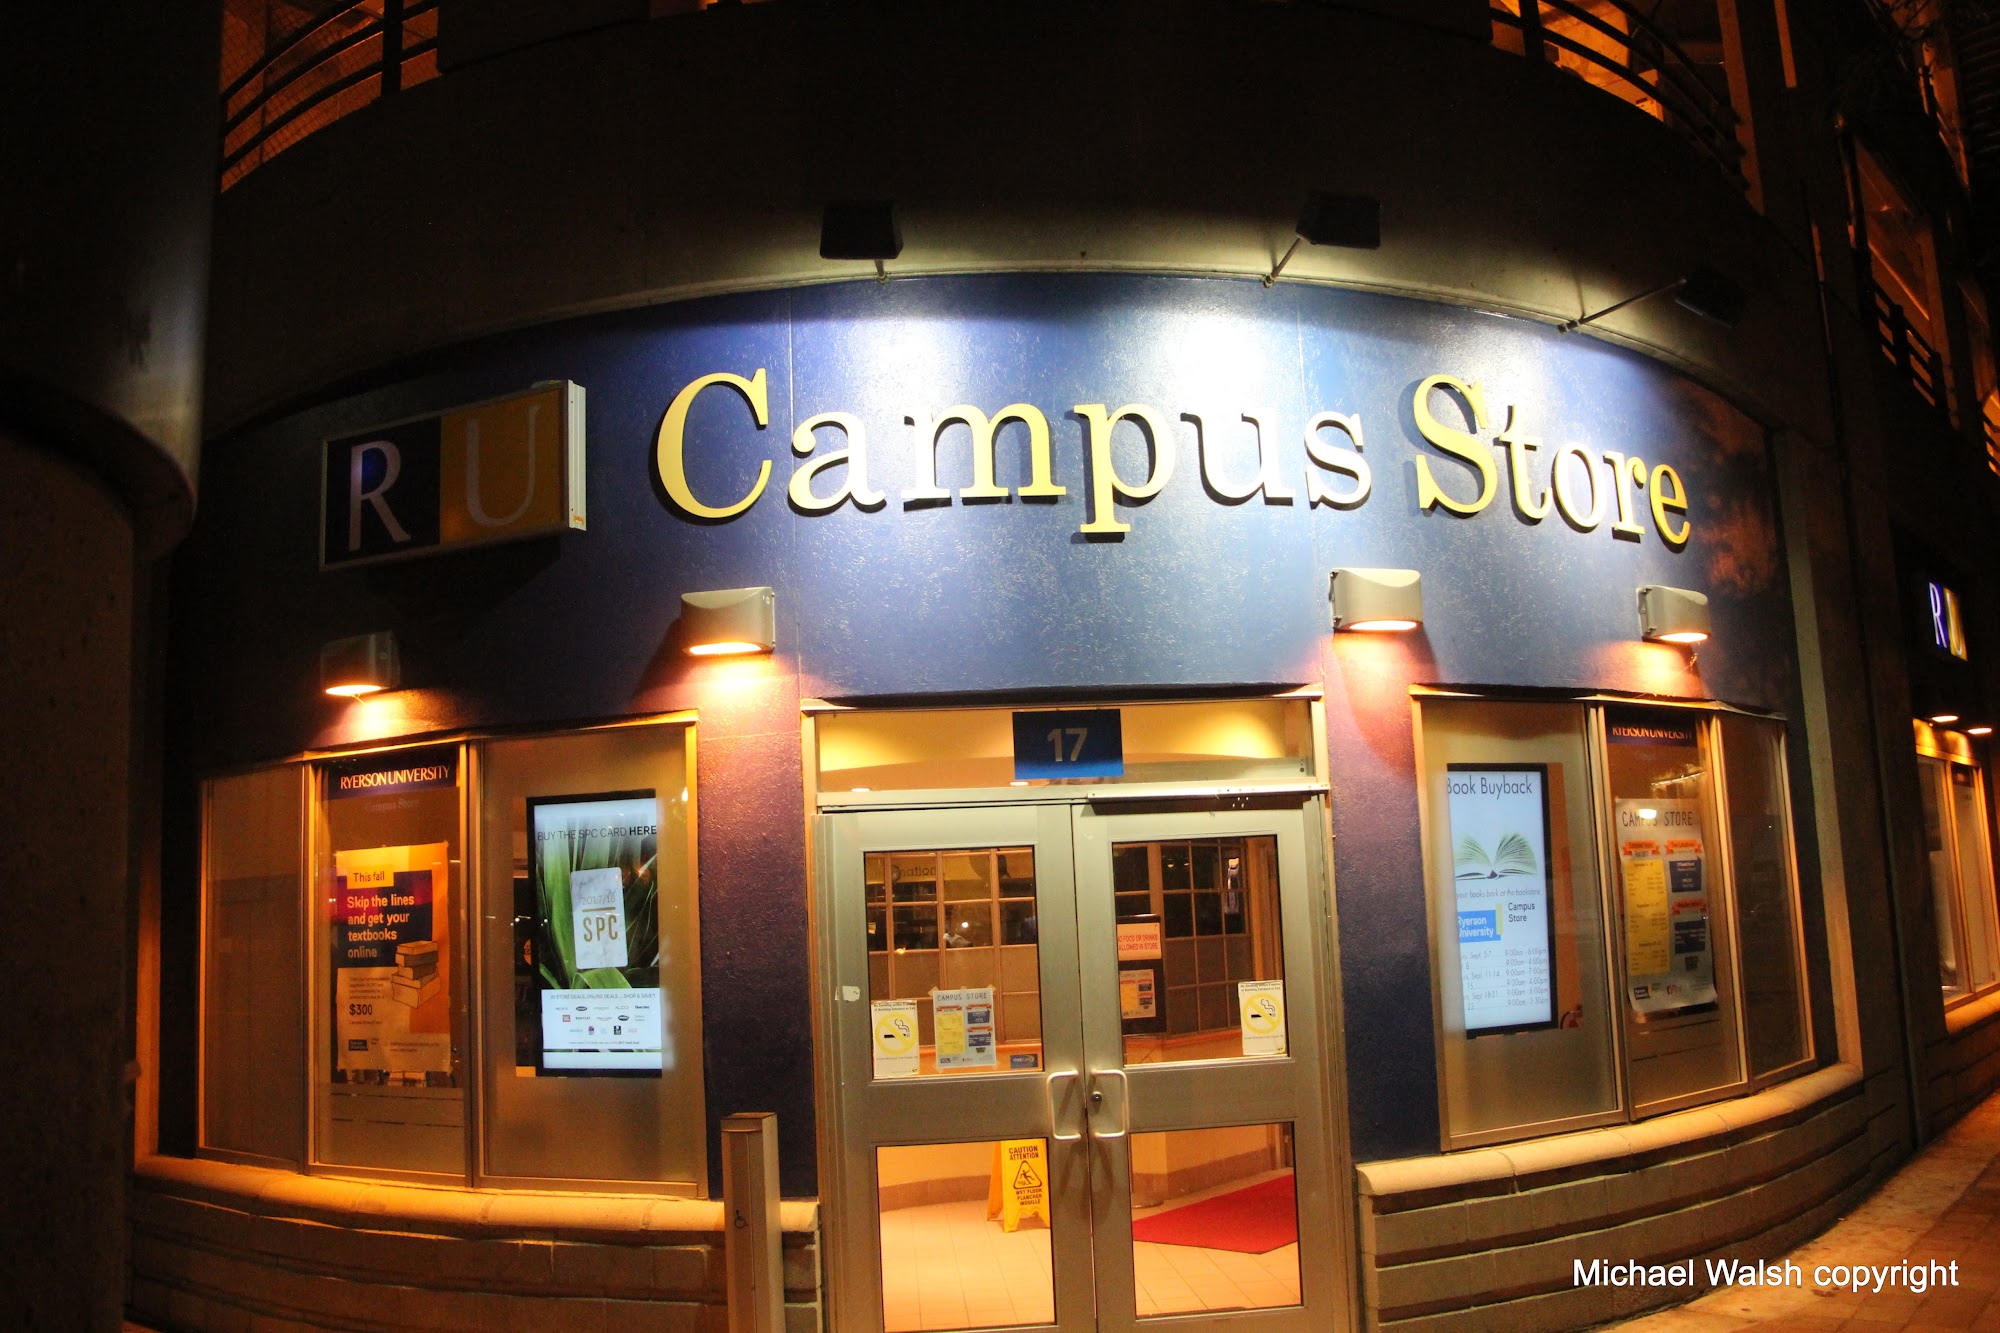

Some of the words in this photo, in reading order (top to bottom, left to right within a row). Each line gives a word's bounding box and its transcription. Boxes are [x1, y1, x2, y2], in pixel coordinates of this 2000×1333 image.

[656, 368, 1372, 534] Campus
[1413, 374, 1691, 546] Store
[1047, 727, 1088, 762] 17
[340, 771, 387, 790] RYERSON
[388, 765, 451, 785] UNIVERSITY
[1480, 774, 1533, 800] Buyback
[1664, 811, 1693, 827] STORE
[537, 830, 556, 841] BUY
[557, 829, 576, 840] THE
[578, 828, 599, 839] SPC
[600, 827, 627, 838] CARD
[629, 825, 656, 836] HERE
[353, 871, 371, 882] This
[373, 870, 385, 881] fall
[347, 895, 370, 911] Skip
[371, 894, 388, 907] the
[391, 893, 415, 906] lines
[1508, 902, 1535, 912] Campus
[347, 913, 366, 925] and
[368, 913, 384, 927] get
[386, 913, 410, 926] your
[1508, 914, 1527, 923] Store
[348, 928, 398, 942] textbooks
[582, 914, 618, 942] SPC
[347, 946, 378, 958] online
[1144, 942, 1158, 950] STORE
[937, 993, 963, 1002] CAMPUS
[966, 992, 987, 1000] STORE
[349, 1003, 373, 1016] $300
[1008, 1145, 1038, 1154] CAUTION
[1010, 1152, 1039, 1161] ATTENTION
